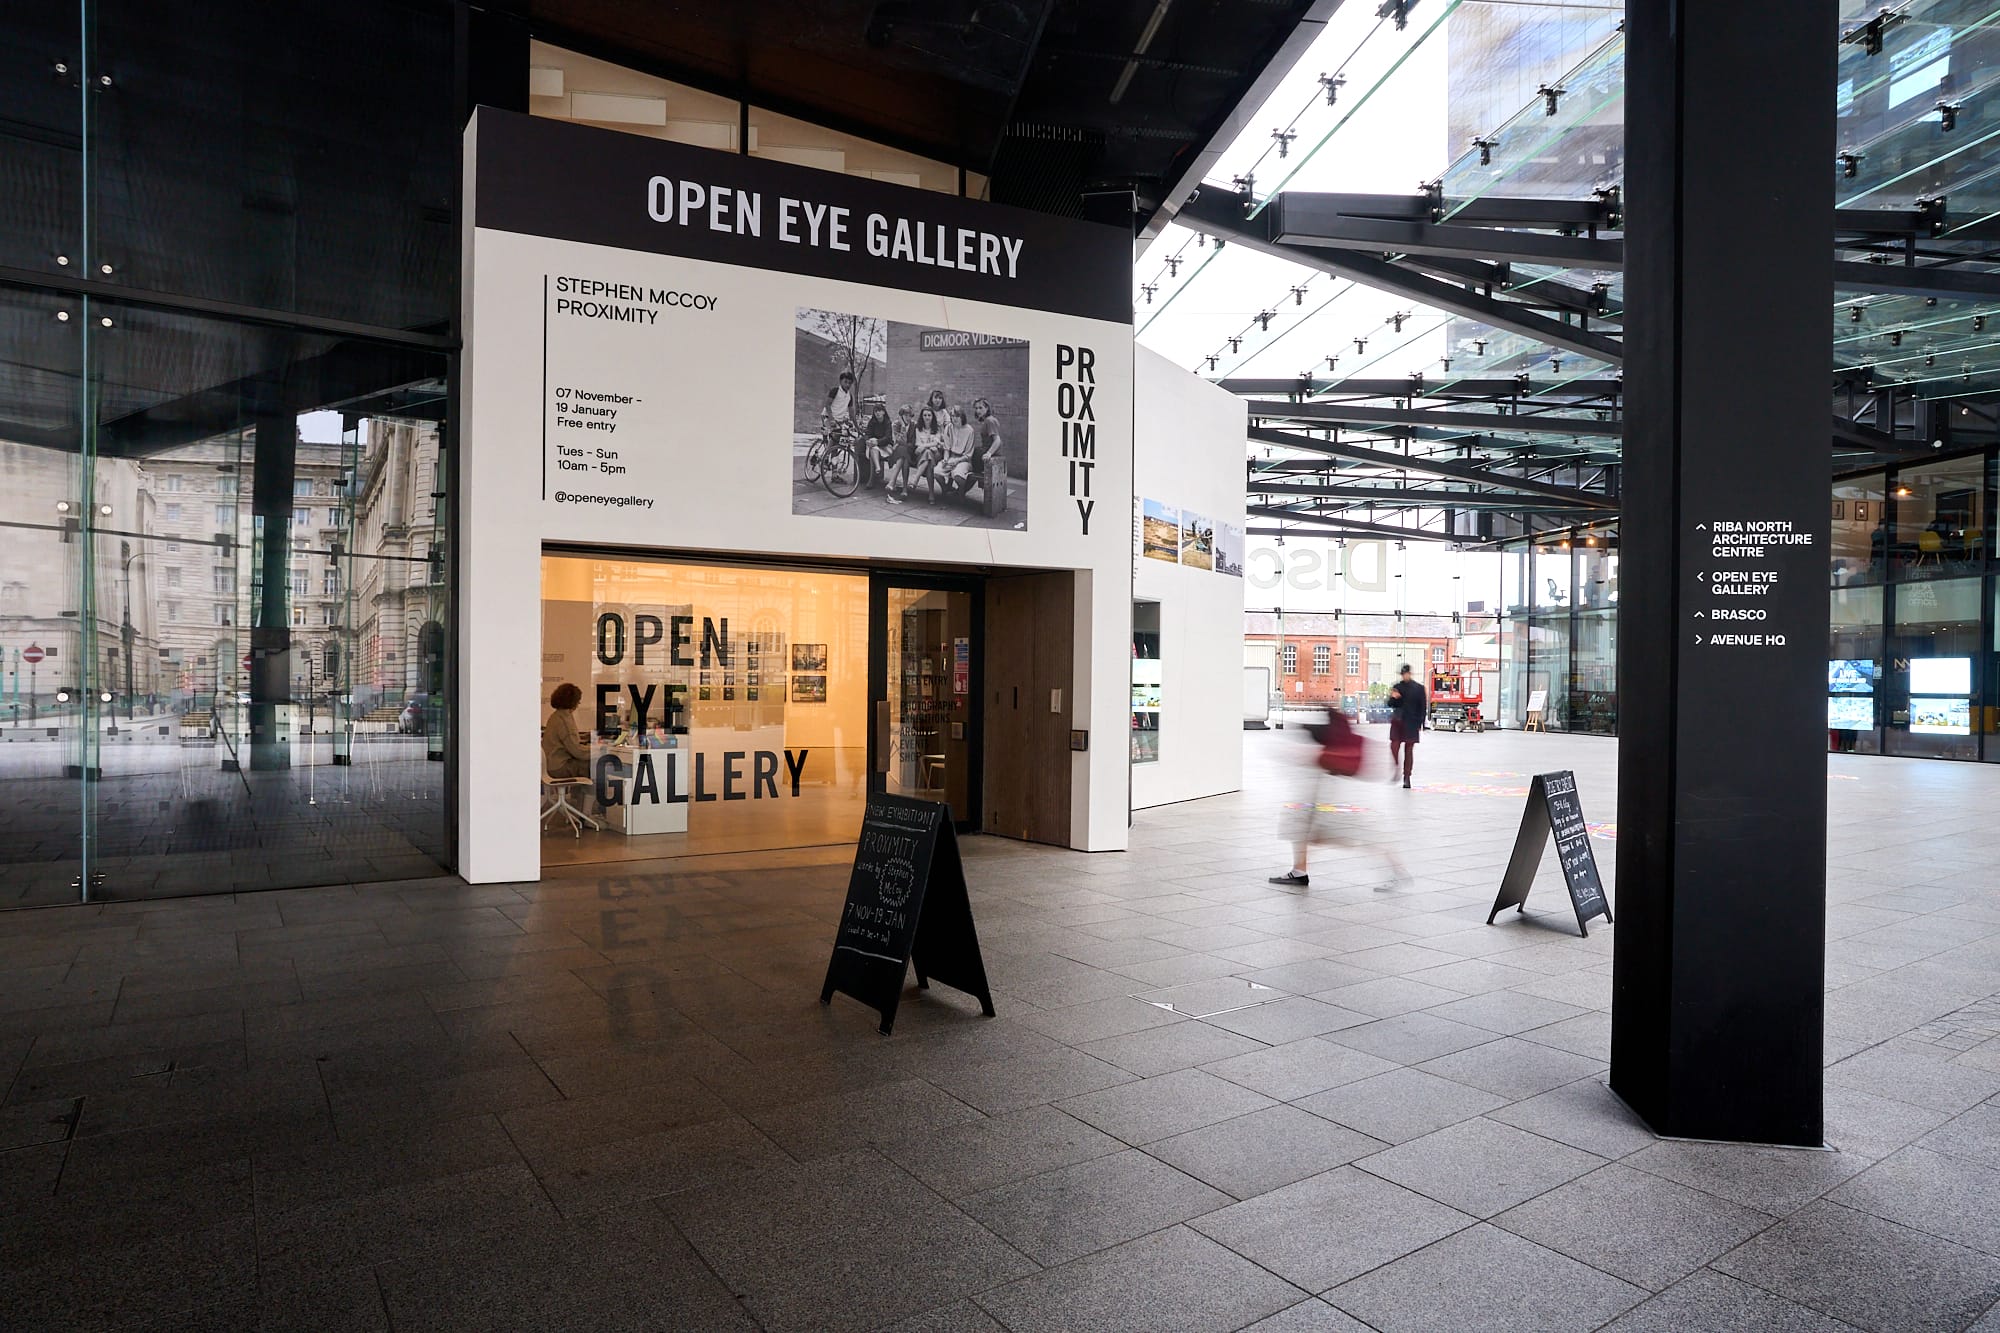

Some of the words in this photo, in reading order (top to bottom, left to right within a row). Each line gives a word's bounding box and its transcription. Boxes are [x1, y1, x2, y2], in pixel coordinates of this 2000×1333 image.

[648, 175, 761, 237] OPEN
[779, 197, 850, 251] EYE
[866, 212, 1024, 279] GALLERY
[556, 276, 643, 301] STEPHEN
[650, 288, 718, 311] MCCOY
[557, 299, 658, 325] PROXIMITY
[924, 333, 969, 348] DIGMOOR
[972, 332, 1003, 346] VIDEO
[1056, 343, 1095, 384] PR
[556, 388, 571, 398] 07
[575, 389, 633, 404] November
[1058, 383, 1095, 422] OX
[556, 402, 568, 412] 19
[571, 404, 617, 419] January
[557, 417, 583, 428] Free
[586, 421, 616, 433] entry
[1062, 421, 1095, 460] IM
[557, 445, 583, 457] Tues
[596, 448, 618, 459] Sun
[557, 460, 588, 471] 10am
[600, 462, 626, 475] 5pm
[1069, 460, 1095, 497] IT
[555, 491, 654, 508] @openeyegallery
[1076, 499, 1095, 536] Y
[1713, 521, 1743, 532] RIBA
[1746, 521, 1792, 532] NORTH
[1712, 534, 1812, 545] ARCHITECTURE
[1712, 546, 1764, 557] CENTRE
[1712, 571, 1748, 582] OPEN
[1752, 571, 1778, 582] EYE
[1712, 584, 1769, 595] GALLERY
[1711, 609, 1767, 620] BRASCO
[597, 612, 728, 667] OPEN
[1710, 634, 1762, 645] AVENUE
[1765, 634, 1786, 646] HQ
[923, 675, 948, 686] ENTRY
[596, 684, 688, 736] EYE
[900, 700, 957, 711] PHOTOGRAPHY
[900, 713, 951, 723] EXHIBITIONS
[900, 751, 921, 763] SHOP
[595, 750, 809, 807] GALLERY
[864, 831, 919, 860] PROXIMITY
[847, 902, 855, 917] 7
[885, 910, 906, 930] JAN
